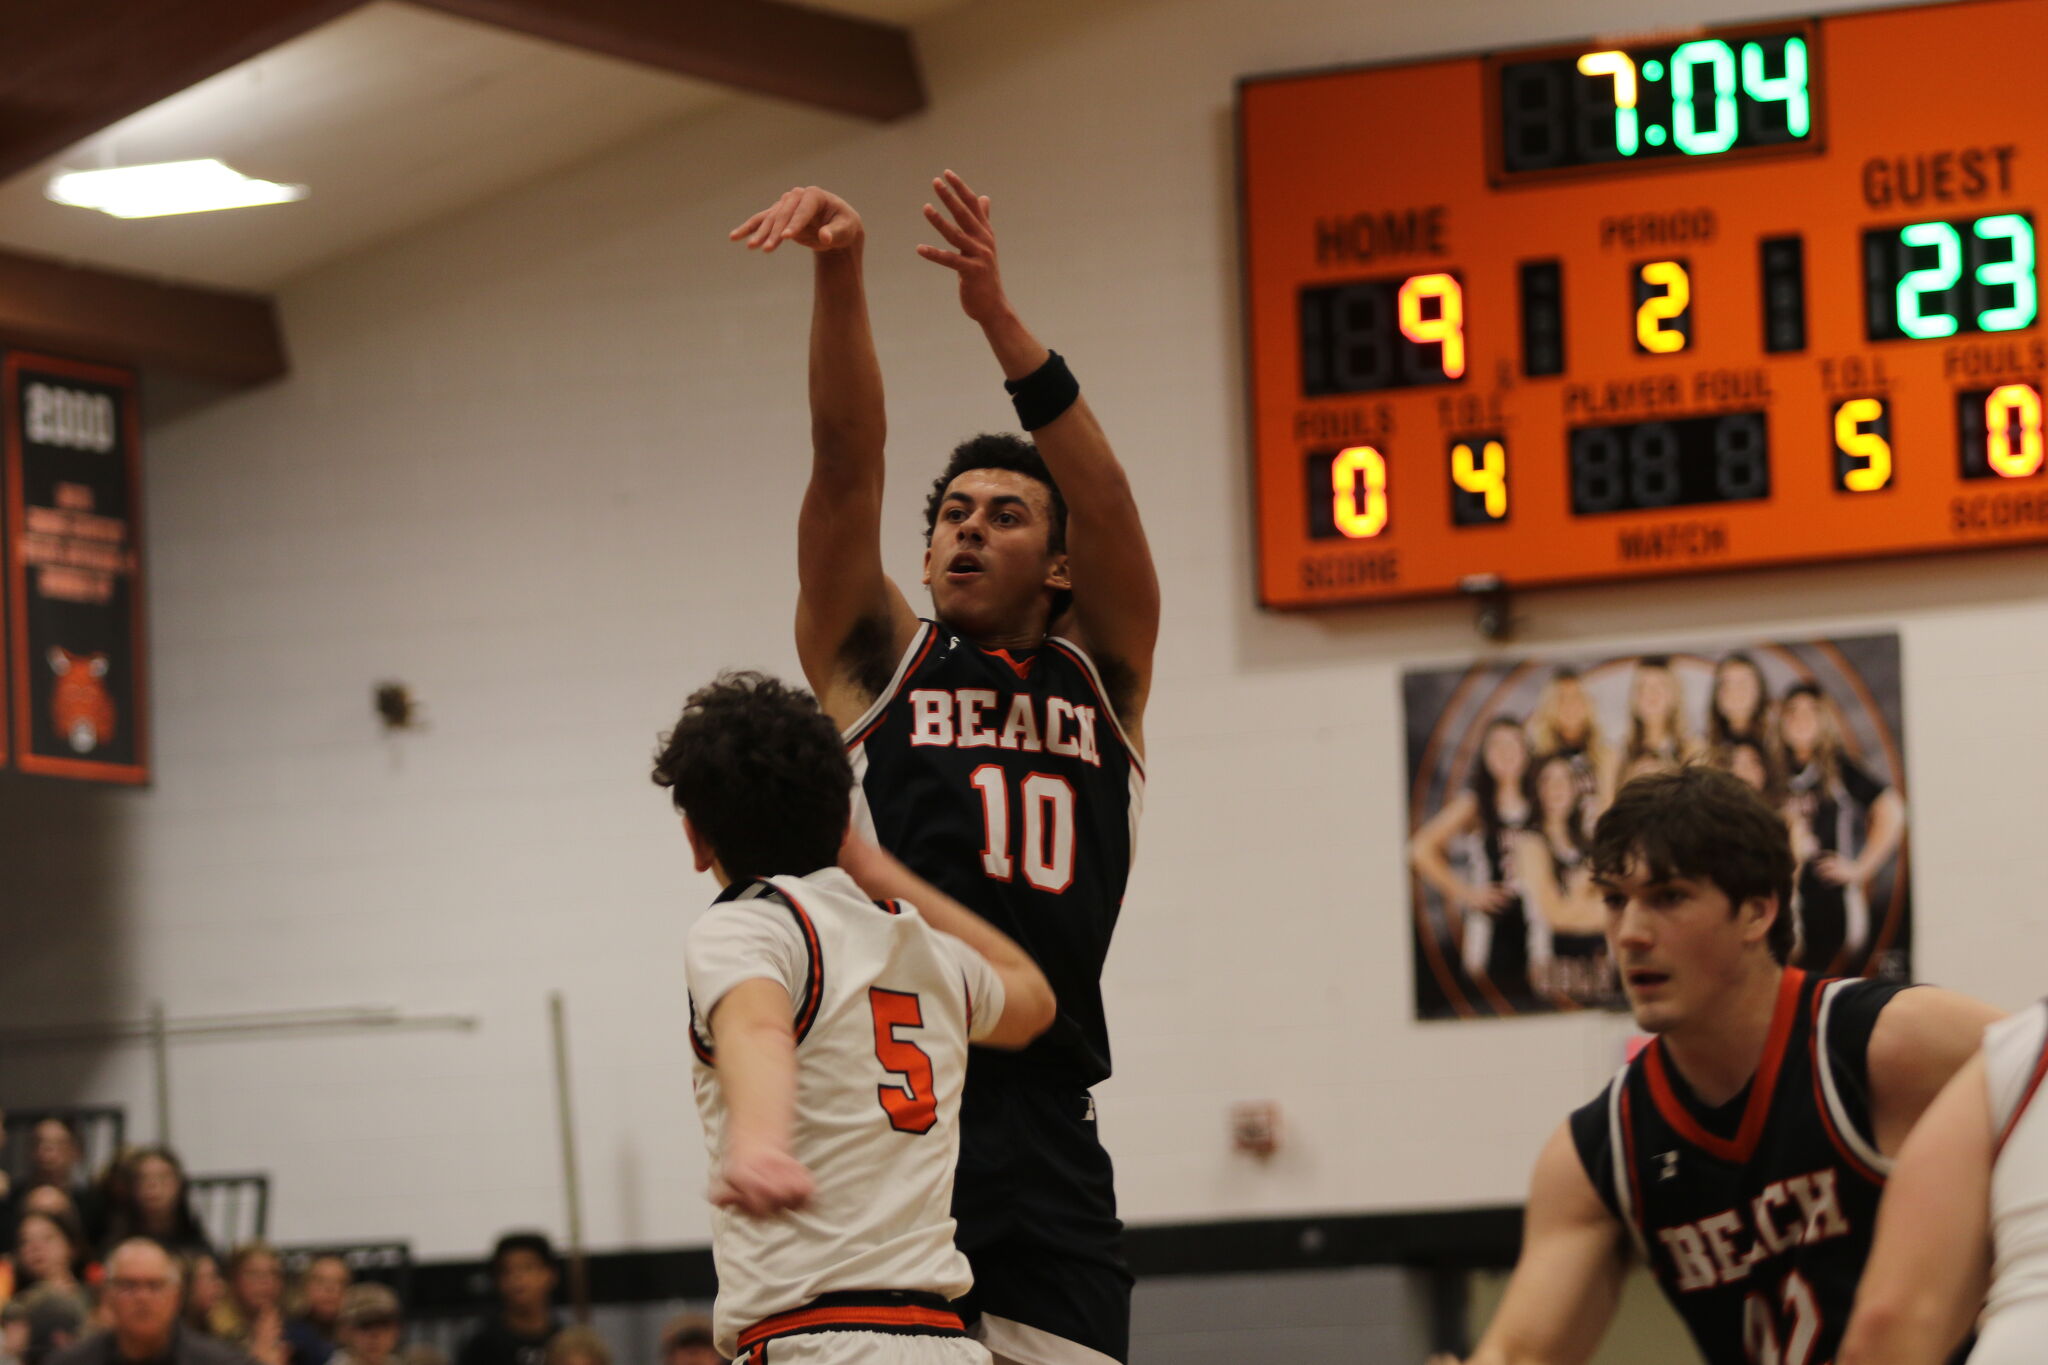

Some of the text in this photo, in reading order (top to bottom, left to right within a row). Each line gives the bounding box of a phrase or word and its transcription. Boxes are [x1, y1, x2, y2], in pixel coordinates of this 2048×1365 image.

[1577, 37, 1810, 156] 7:04
[1862, 143, 2017, 211] GUEST
[1313, 206, 1451, 268] HOME
[1600, 208, 1717, 252] PERIOD
[1637, 261, 1690, 353] 2
[1896, 213, 2037, 340] 23
[1398, 273, 1465, 379] 9
[1945, 336, 2048, 381] FOULS
[1294, 403, 1395, 440] FOULS
[1562, 368, 1772, 415] PLAYER FOUL
[1985, 384, 2044, 478] 0
[1452, 441, 1507, 518] 4
[1835, 398, 1892, 492] 5
[1332, 446, 1388, 538] 0
[1950, 488, 2048, 534] SCORE
[1302, 551, 1398, 590] SCORE
[1617, 521, 1727, 562] MATCH
[909, 687, 1101, 768] BEACH
[969, 763, 1076, 895] 10
[868, 986, 938, 1135] 5
[1657, 1166, 1850, 1294] BECH
